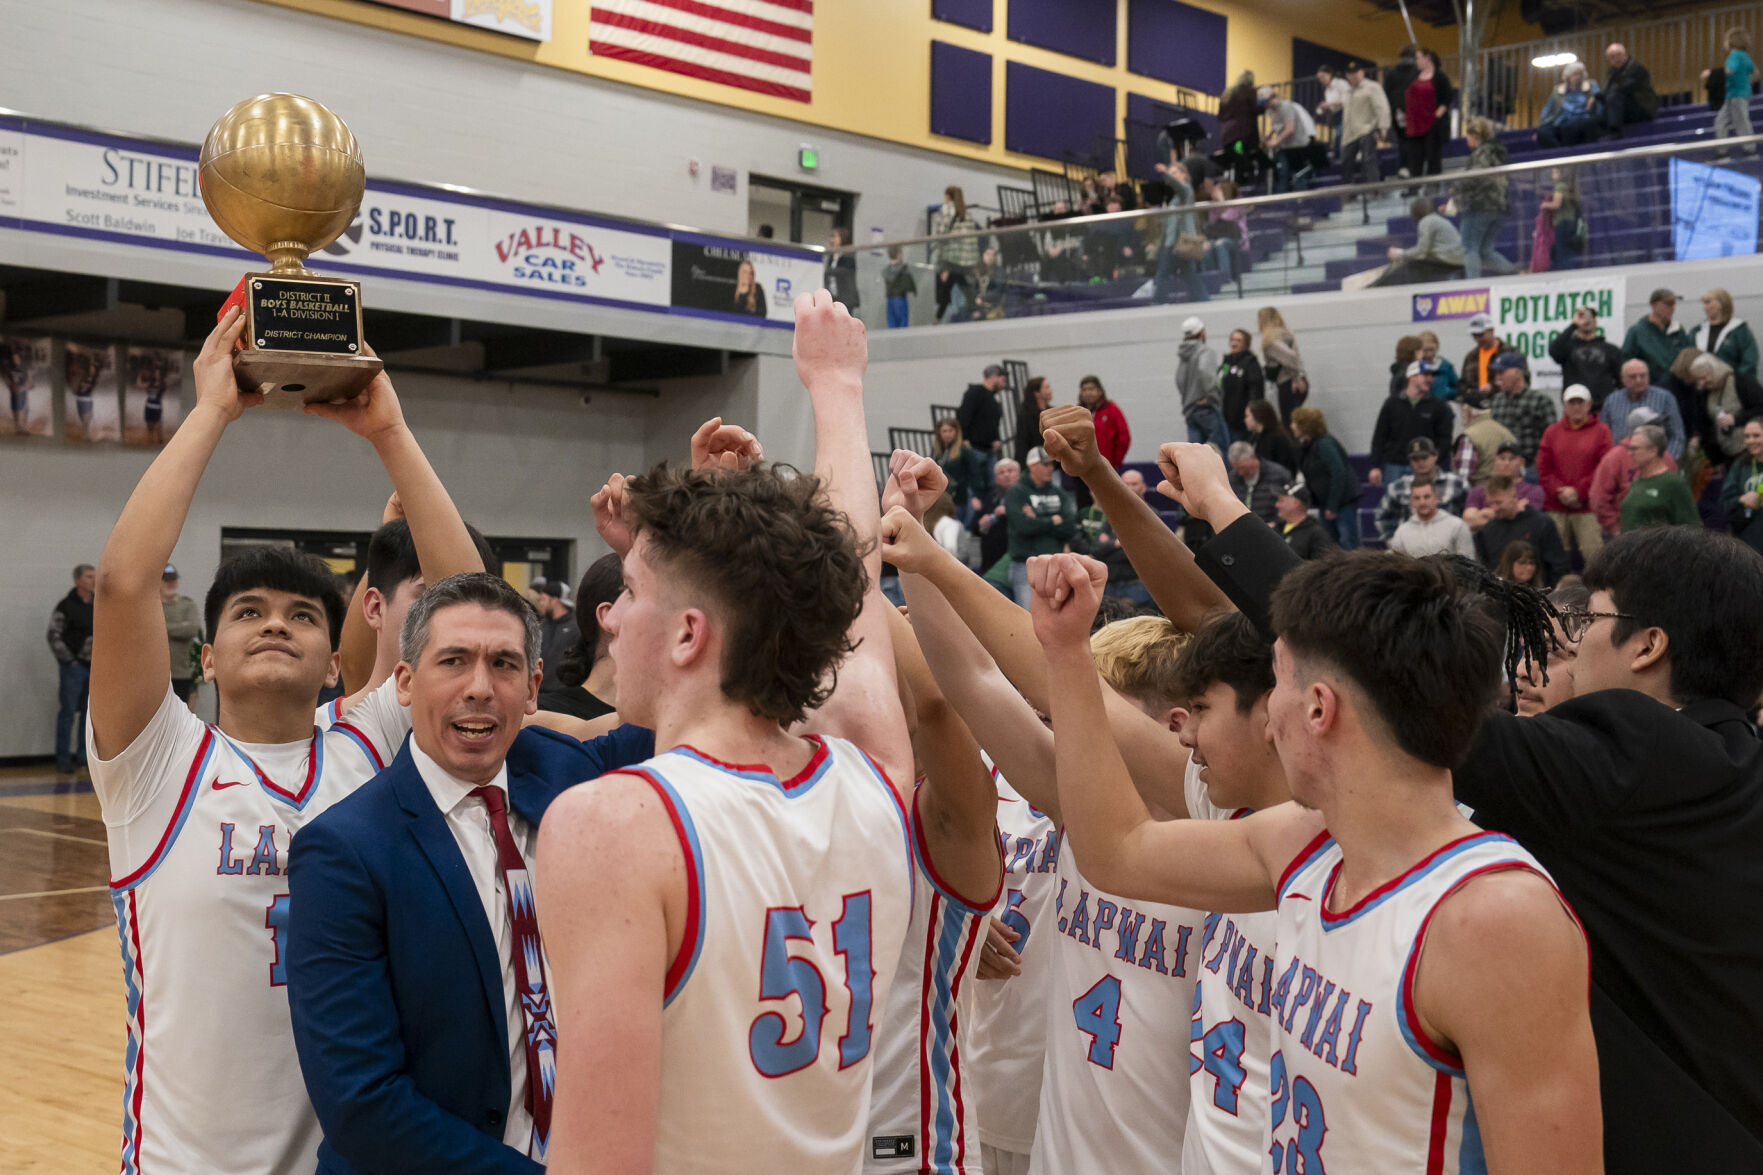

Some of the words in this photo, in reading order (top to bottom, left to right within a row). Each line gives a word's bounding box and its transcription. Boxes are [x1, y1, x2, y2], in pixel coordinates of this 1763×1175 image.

[66, 184, 129, 205] Investment
[134, 194, 180, 212] Services
[66, 209, 101, 226] Scott
[104, 212, 156, 234] Baldwin
[369, 207, 458, 246] S.P.O.R.T.
[495, 226, 604, 274] VALLEY
[524, 254, 576, 272] CAR
[513, 267, 587, 287] SALES
[261, 299, 287, 308] BOYS
[289, 301, 350, 312] BASKETBALL
[279, 291, 321, 302] DISTRICT
[1436, 293, 1488, 316] AWAY
[1500, 289, 1613, 325] POTLATCH
[272, 309, 288, 318] 1-A
[290, 310, 333, 320] DIVISION
[264, 330, 302, 339] DISTRICT
[304, 332, 347, 341] CHAMPION
[217, 822, 292, 876] LA
[1055, 877, 1193, 978] LAPWAI
[748, 888, 876, 1079] 51
[1072, 973, 1122, 1071] 4
[1270, 955, 1373, 1077] APWAI
[900, 1142, 909, 1151] M
